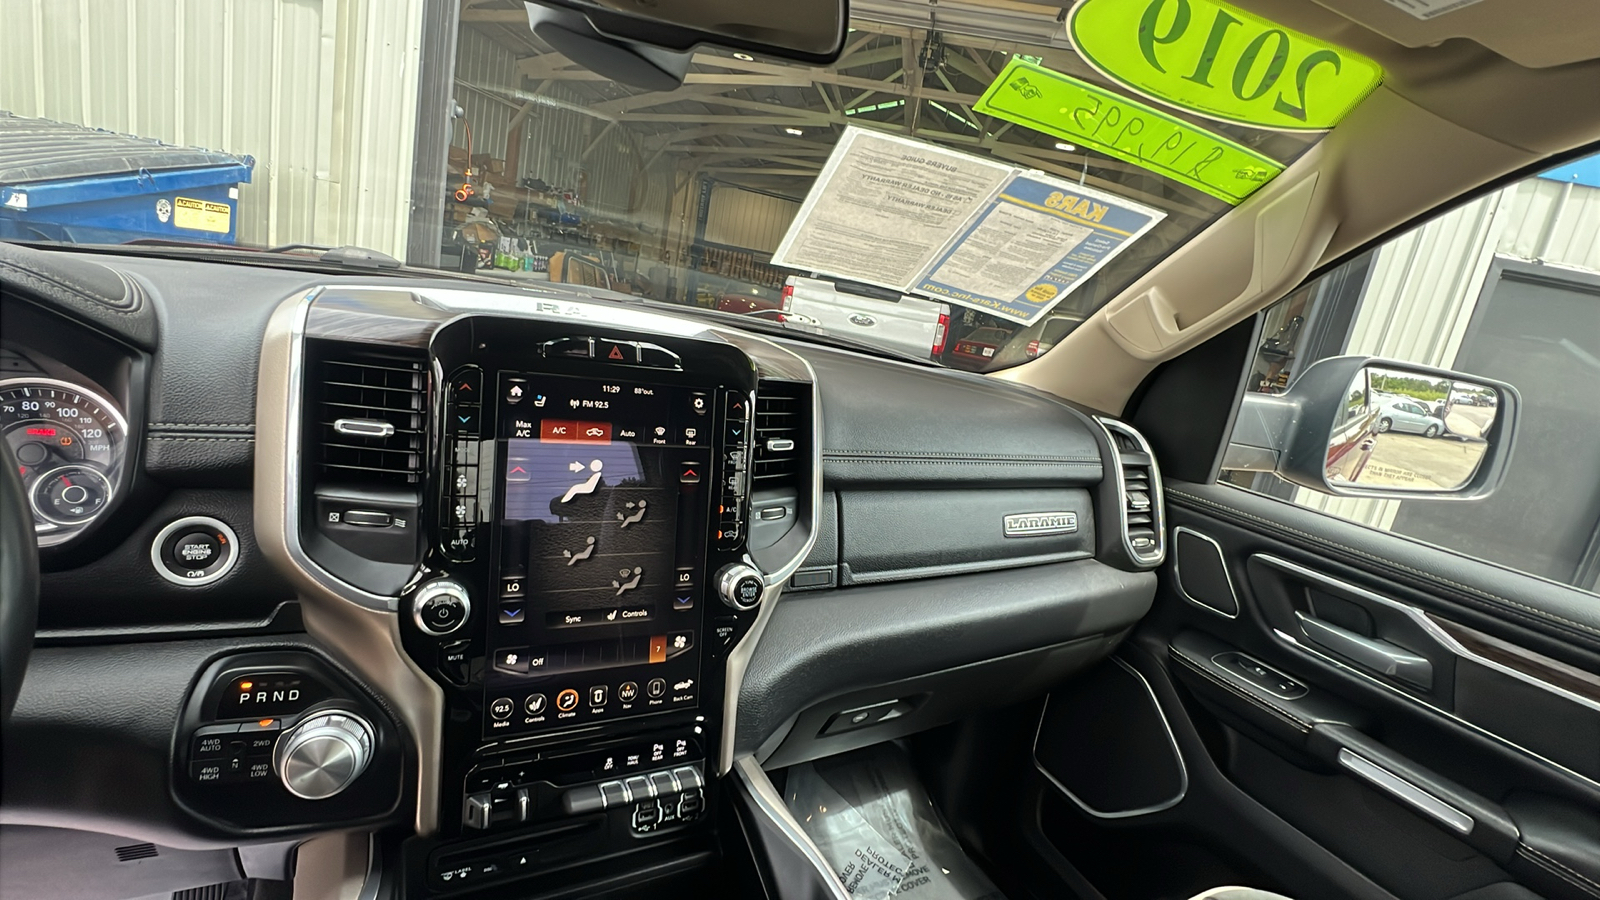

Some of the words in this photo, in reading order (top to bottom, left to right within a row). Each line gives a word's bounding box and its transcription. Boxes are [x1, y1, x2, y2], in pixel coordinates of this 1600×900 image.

[602, 385, 621, 394] 11:29
[582, 400, 594, 408] FM
[594, 401, 609, 410] 92.5
[21, 401, 40, 411] 80
[56, 408, 79, 417] 100
[81, 429, 102, 438] 120
[515, 419, 532, 429] Max
[515, 429, 531, 438] A/C
[552, 426, 567, 435] A/C
[620, 429, 636, 438] Auto
[89, 444, 110, 452] MPH
[1007, 516, 1075, 530] LARAMIE
[450, 538, 469, 547] AUTO
[679, 572, 690, 582] LO
[506, 582, 520, 593] LO
[622, 609, 649, 619] Controls
[565, 614, 582, 625] Sync
[447, 653, 464, 662] MUTE
[532, 656, 544, 667] Off
[239, 693, 251, 704] P
[256, 691, 268, 703] R
[272, 690, 285, 702] N
[288, 689, 300, 701] D
[621, 690, 636, 698] NW
[494, 704, 510, 713] 92.5
[201, 738, 221, 746] 4WD
[252, 739, 271, 748] 2WD
[199, 744, 222, 752] AUTO
[200, 766, 220, 774] 4WD
[250, 763, 269, 771] 4WD
[198, 772, 220, 781] HIGH
[250, 770, 268, 778] LOW
[901, 876, 931, 892] COVER
